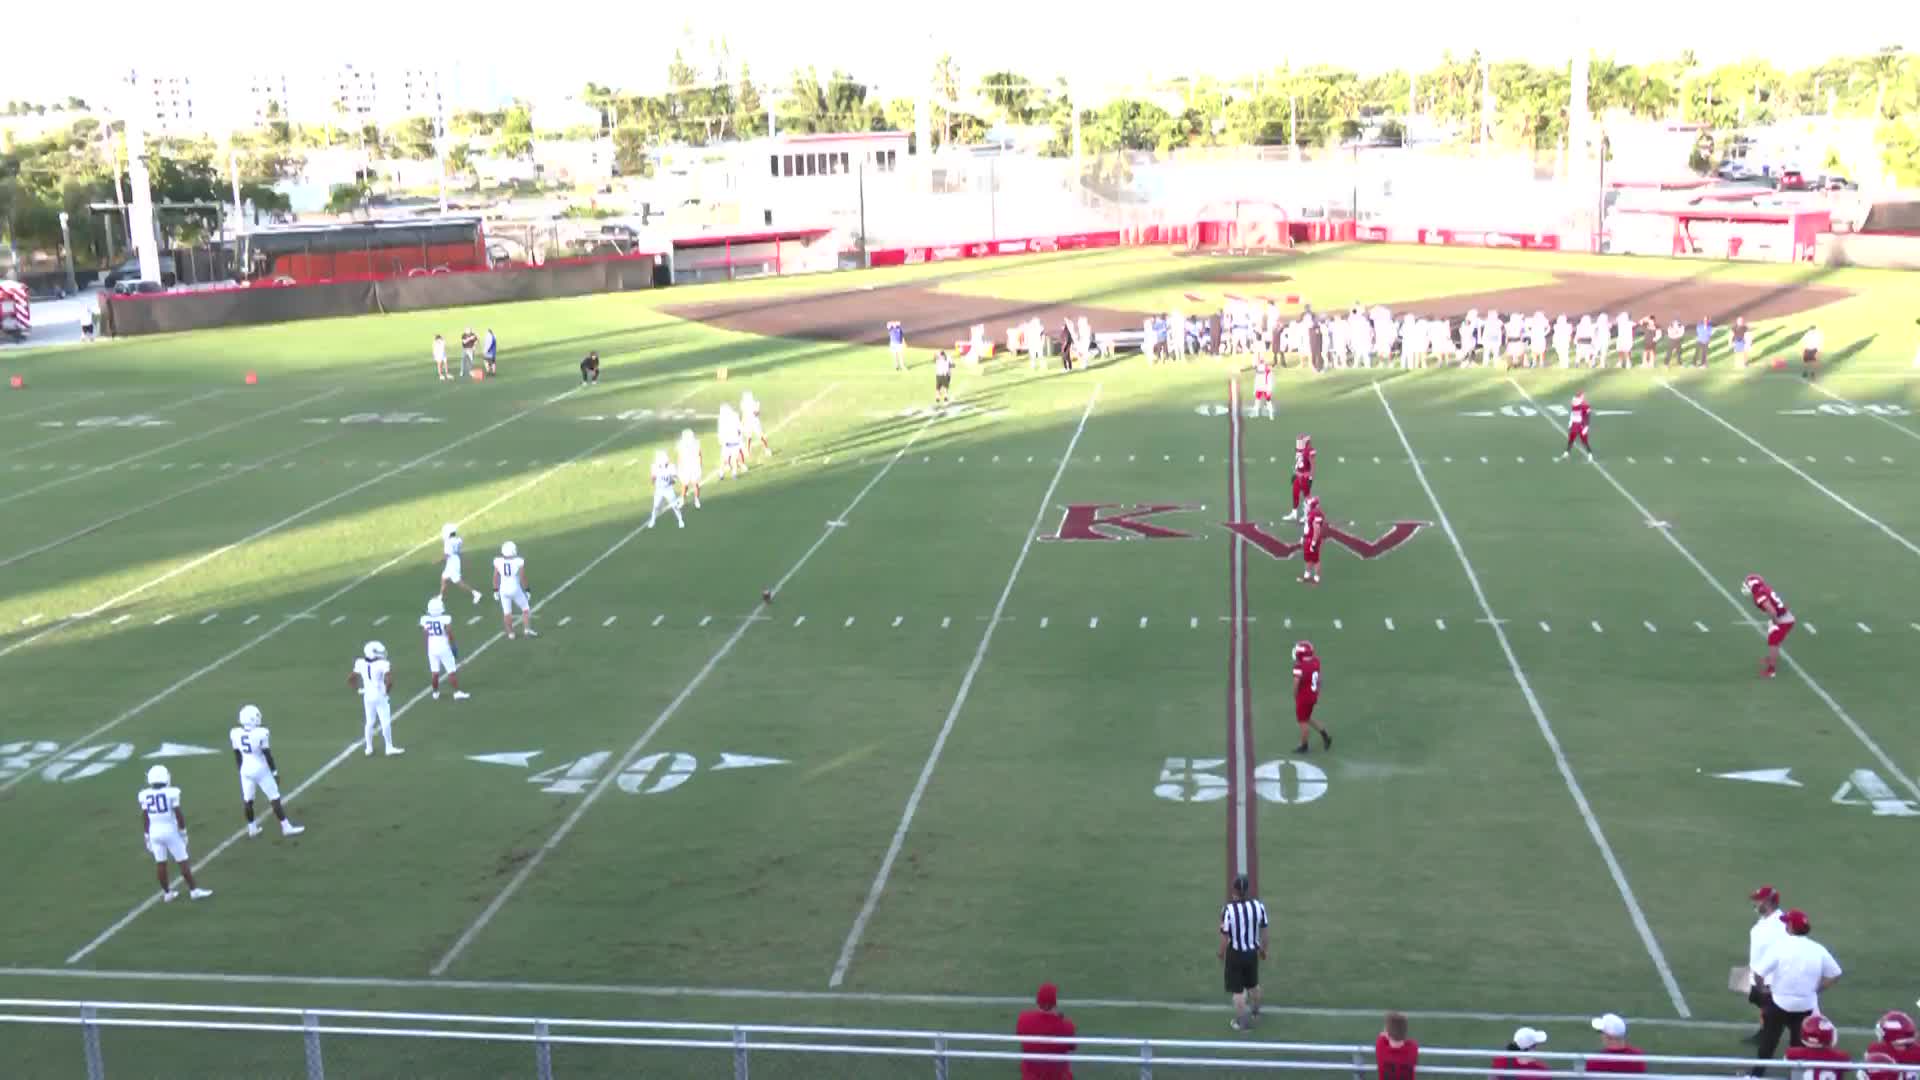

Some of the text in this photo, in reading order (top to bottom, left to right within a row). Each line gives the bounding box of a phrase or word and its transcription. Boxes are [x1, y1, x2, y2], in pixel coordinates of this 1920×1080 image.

[425, 620, 443, 637] 28
[240, 735, 253, 754] 5
[527, 751, 698, 794] 40
[1153, 757, 1329, 804] 50
[145, 793, 169, 814] 20
